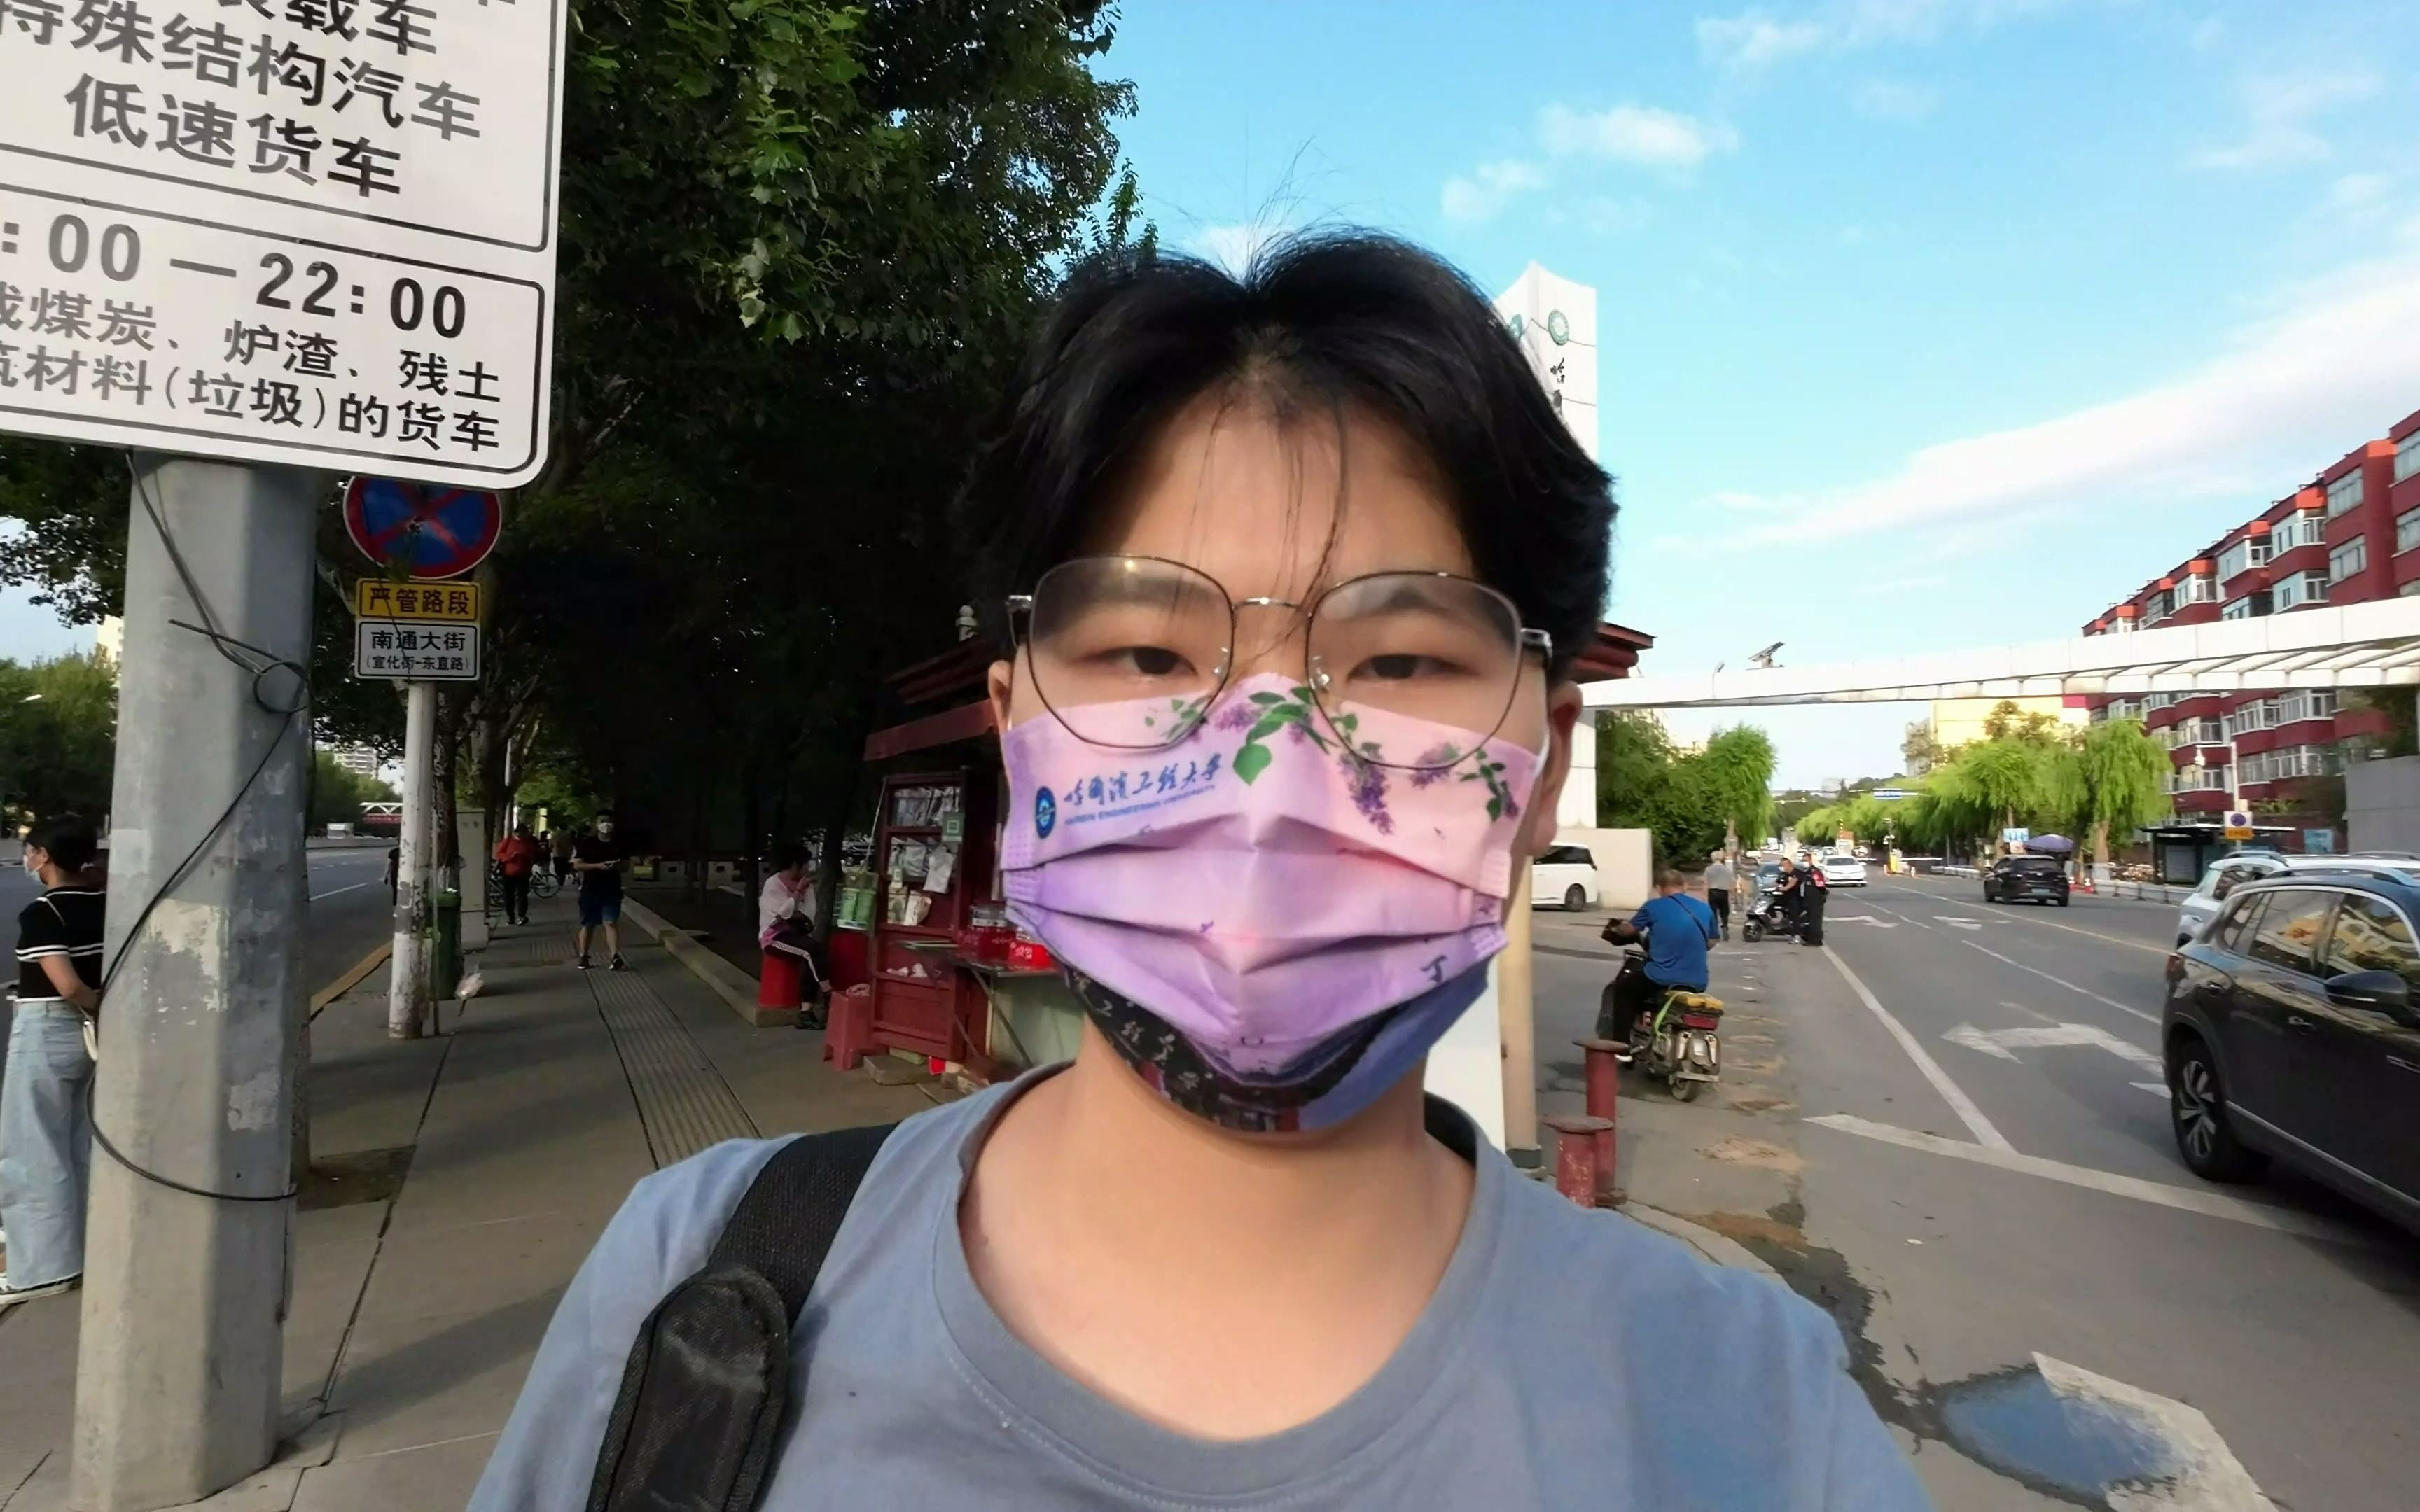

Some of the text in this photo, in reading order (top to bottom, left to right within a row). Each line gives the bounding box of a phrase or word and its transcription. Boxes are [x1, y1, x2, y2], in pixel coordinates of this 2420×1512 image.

[219, 0, 438, 56] 载车
[64, 73, 401, 197] 低速货车
[370, 587, 470, 615] 严管路段
[371, 630, 466, 651] 南通大街
